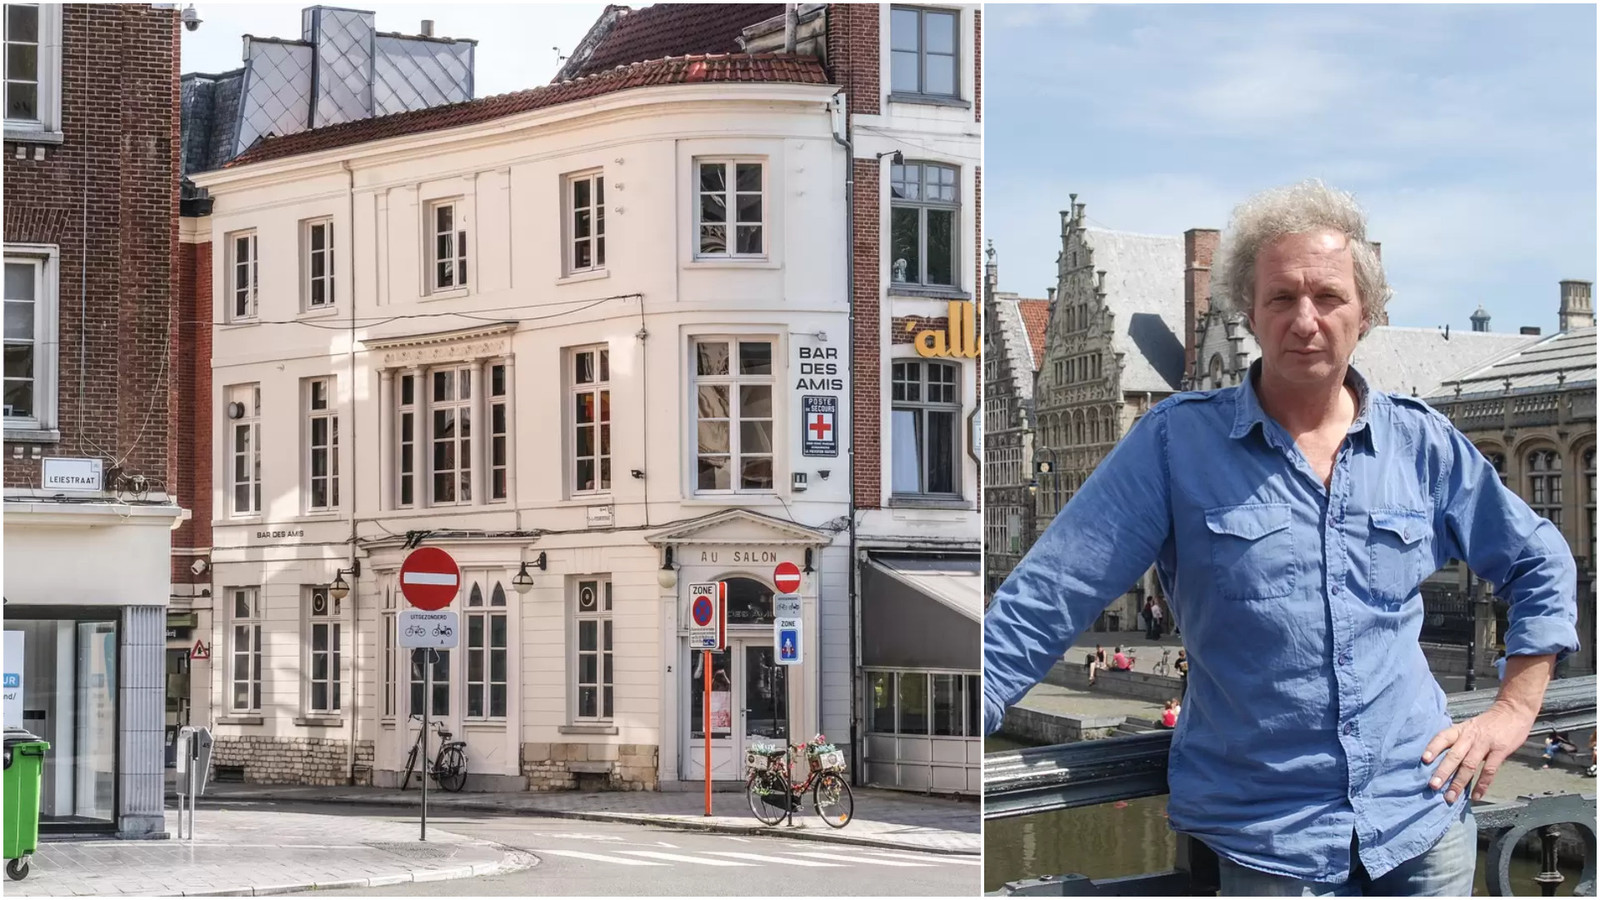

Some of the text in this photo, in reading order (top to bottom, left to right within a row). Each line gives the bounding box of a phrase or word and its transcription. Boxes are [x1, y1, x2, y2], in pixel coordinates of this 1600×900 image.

[905, 300, 981, 358] 'all
[799, 347, 837, 359] BAR
[801, 363, 837, 375] DES
[796, 378, 843, 390] AMIS
[49, 475, 95, 484] LEIESTRAAT
[256, 530, 304, 539] BAR DES AMIS
[701, 551, 777, 563] AU SALON
[692, 586, 713, 595] ZONE
[667, 665, 672, 673] 2
